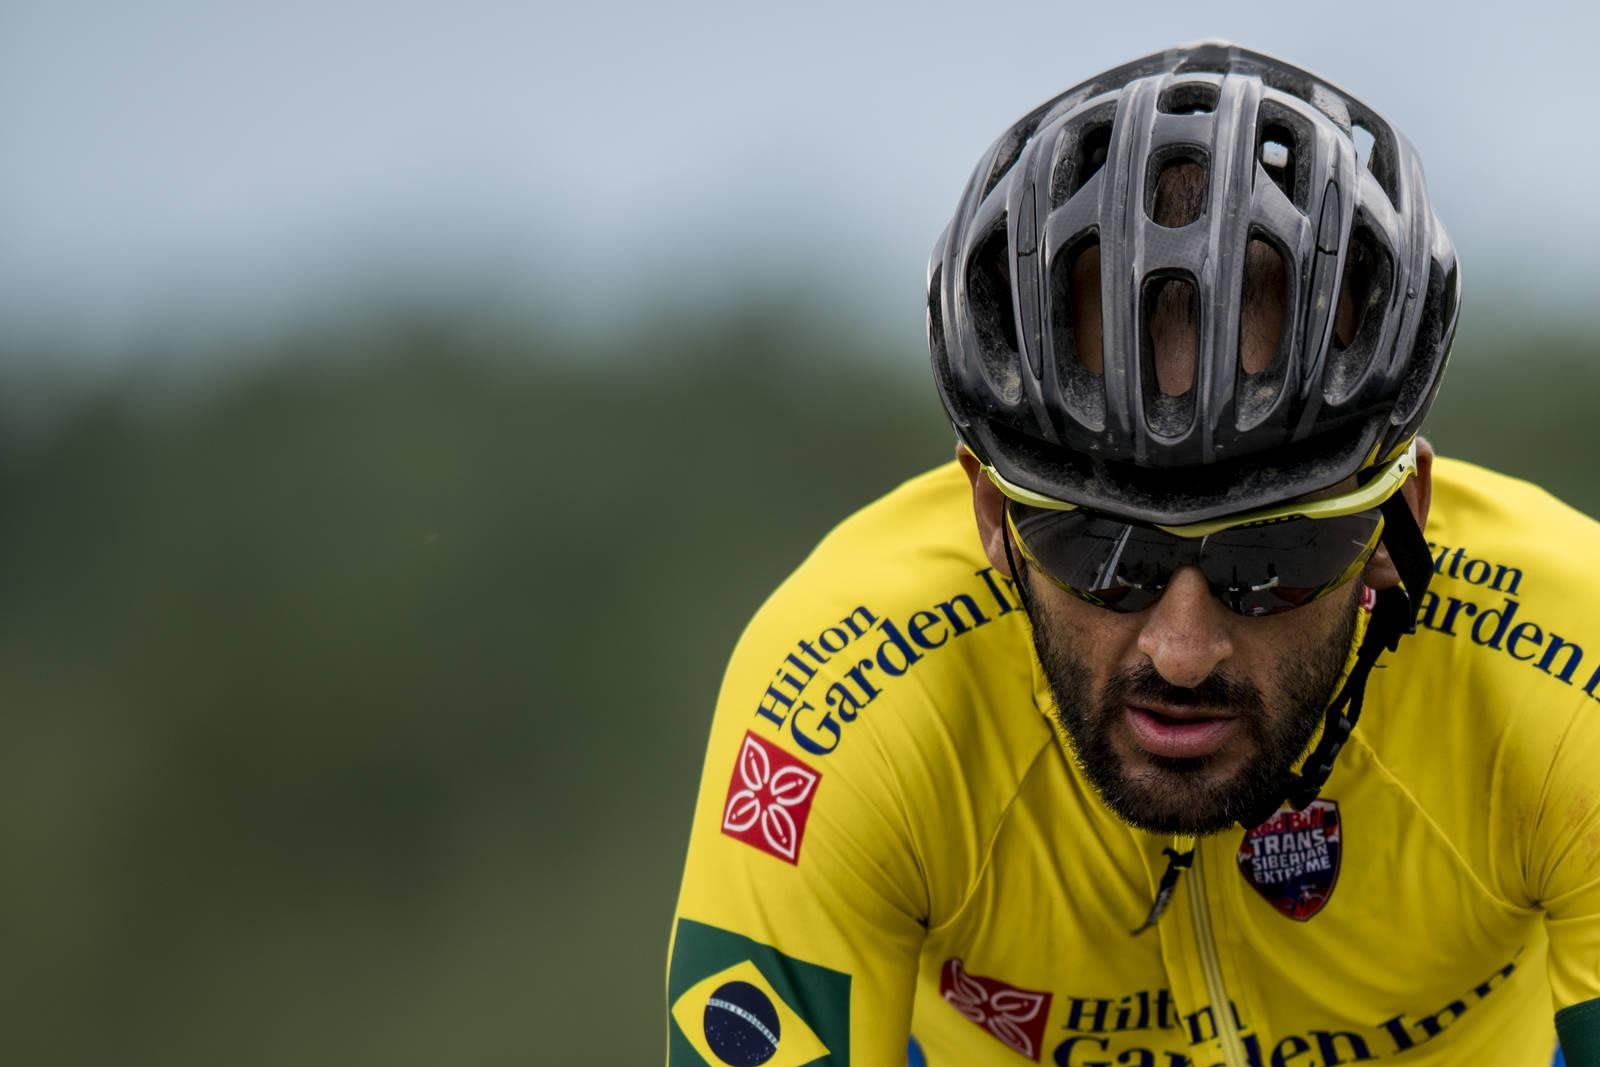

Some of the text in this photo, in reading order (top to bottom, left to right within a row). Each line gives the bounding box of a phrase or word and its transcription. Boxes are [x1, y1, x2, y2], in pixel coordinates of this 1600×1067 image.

[1428, 542, 1523, 596] lton
[754, 605, 879, 730] Hilton
[790, 593, 992, 756] Garden
[1417, 589, 1585, 685] arden
[1250, 828, 1326, 856] TRANS
[1251, 844, 1328, 871] SIBERIAN
